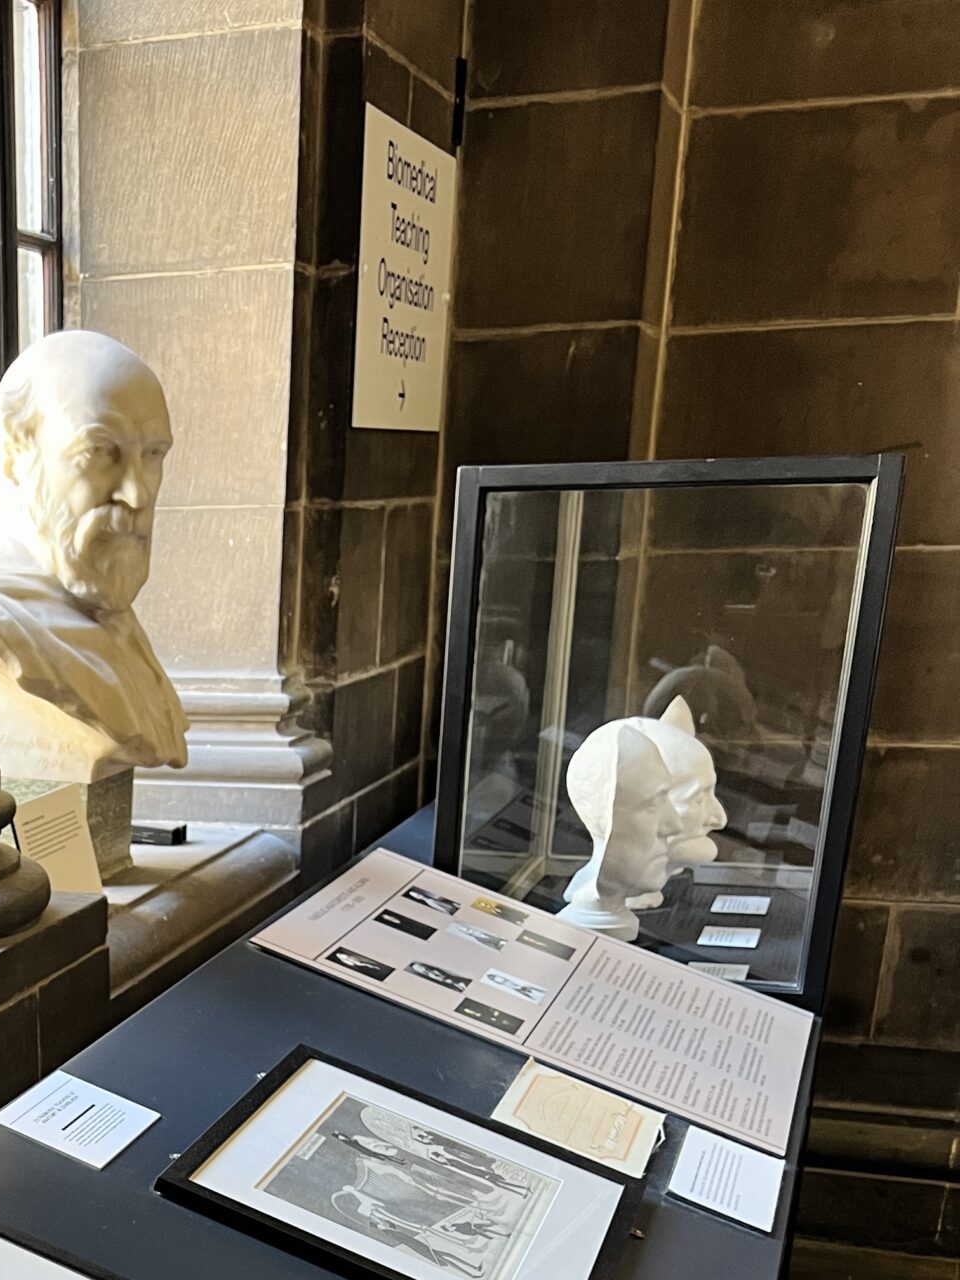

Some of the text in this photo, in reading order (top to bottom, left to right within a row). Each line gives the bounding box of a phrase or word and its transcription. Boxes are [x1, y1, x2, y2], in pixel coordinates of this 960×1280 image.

[387, 140, 438, 205] Biomedical
[390, 203, 430, 265] Teaching
[378, 257, 434, 312] Organisation
[380, 317, 426, 368] Reception
